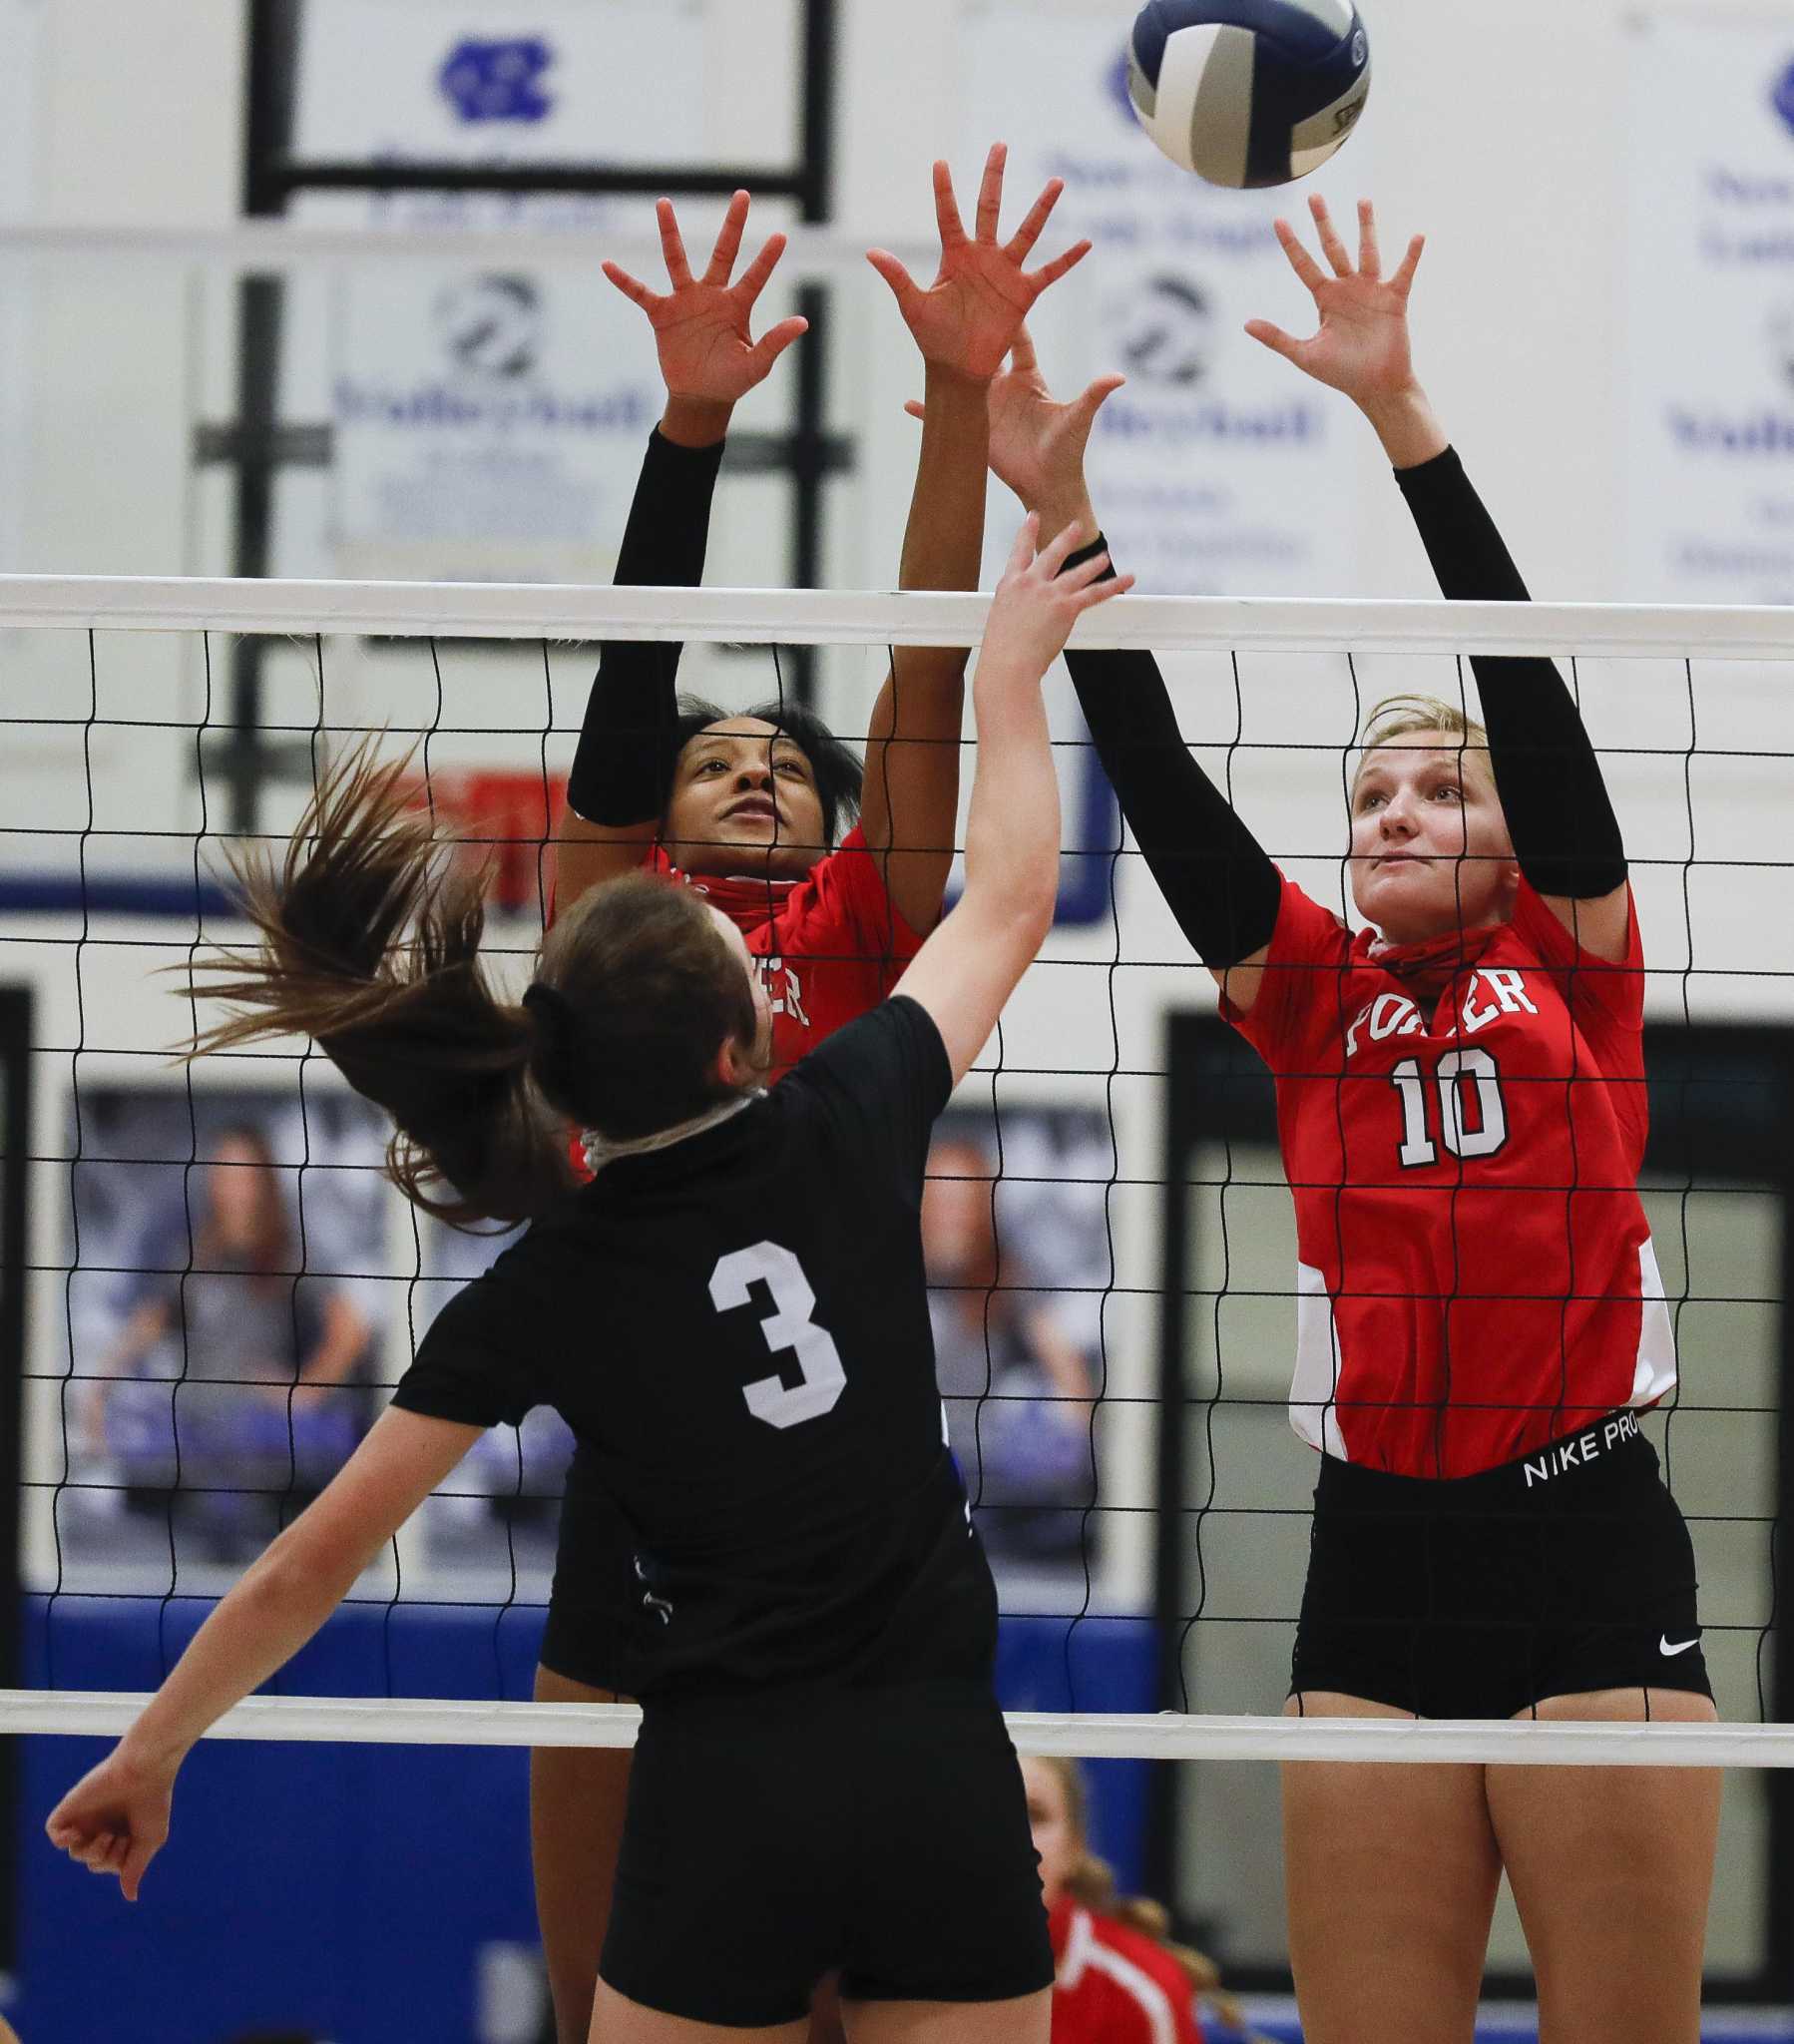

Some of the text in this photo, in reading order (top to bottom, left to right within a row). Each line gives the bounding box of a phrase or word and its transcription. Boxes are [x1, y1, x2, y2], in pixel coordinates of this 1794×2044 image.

[1389, 1045, 1510, 1169] 10
[707, 1239, 848, 1430] 3
[1523, 1409, 1639, 1488] NIKE PRO
